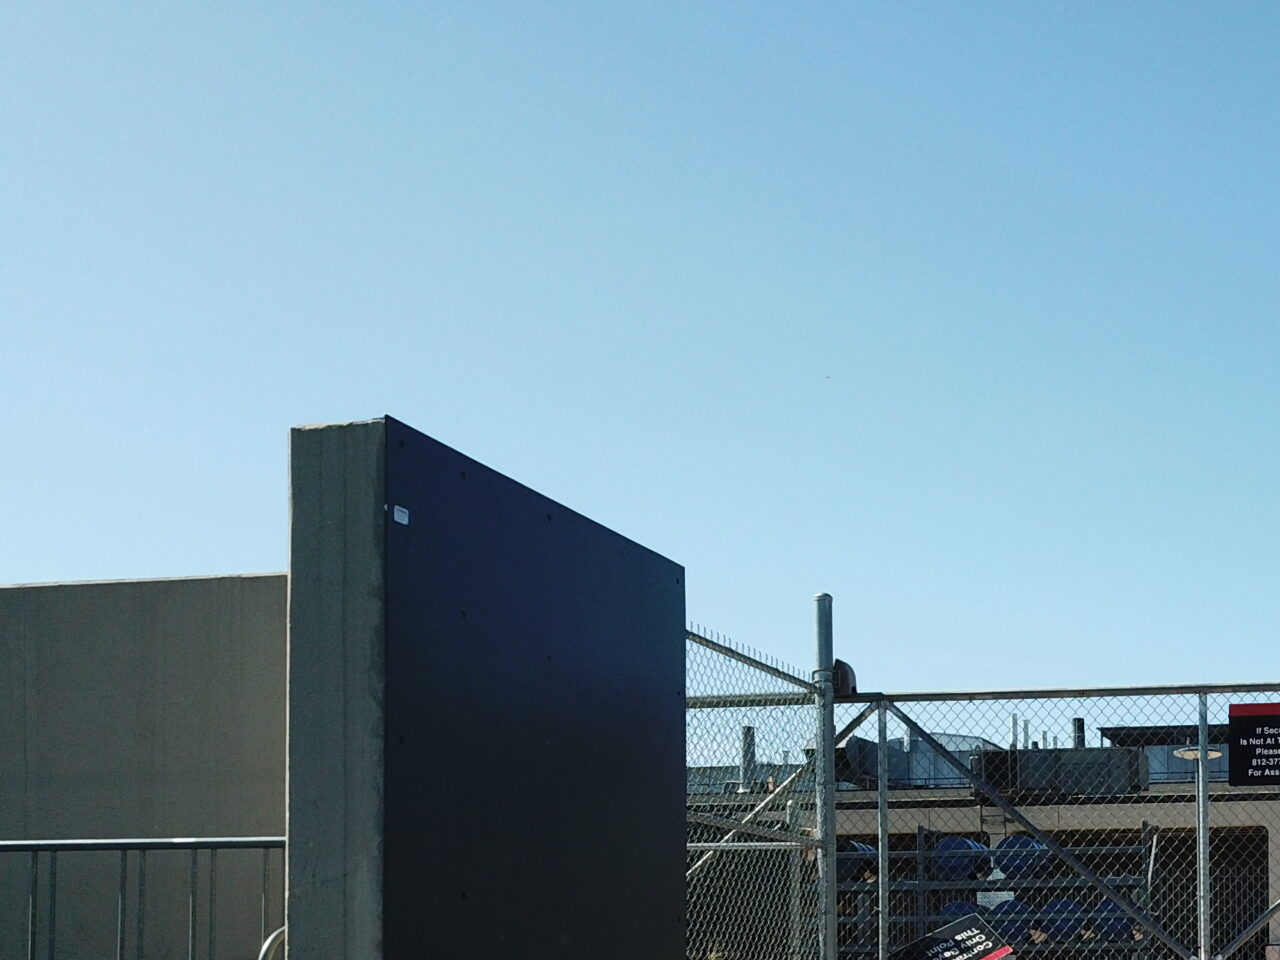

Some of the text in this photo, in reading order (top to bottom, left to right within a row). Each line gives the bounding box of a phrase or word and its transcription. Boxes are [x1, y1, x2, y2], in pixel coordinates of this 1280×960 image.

[927, 927, 980, 956] This Point
[960, 934, 986, 949] Only
